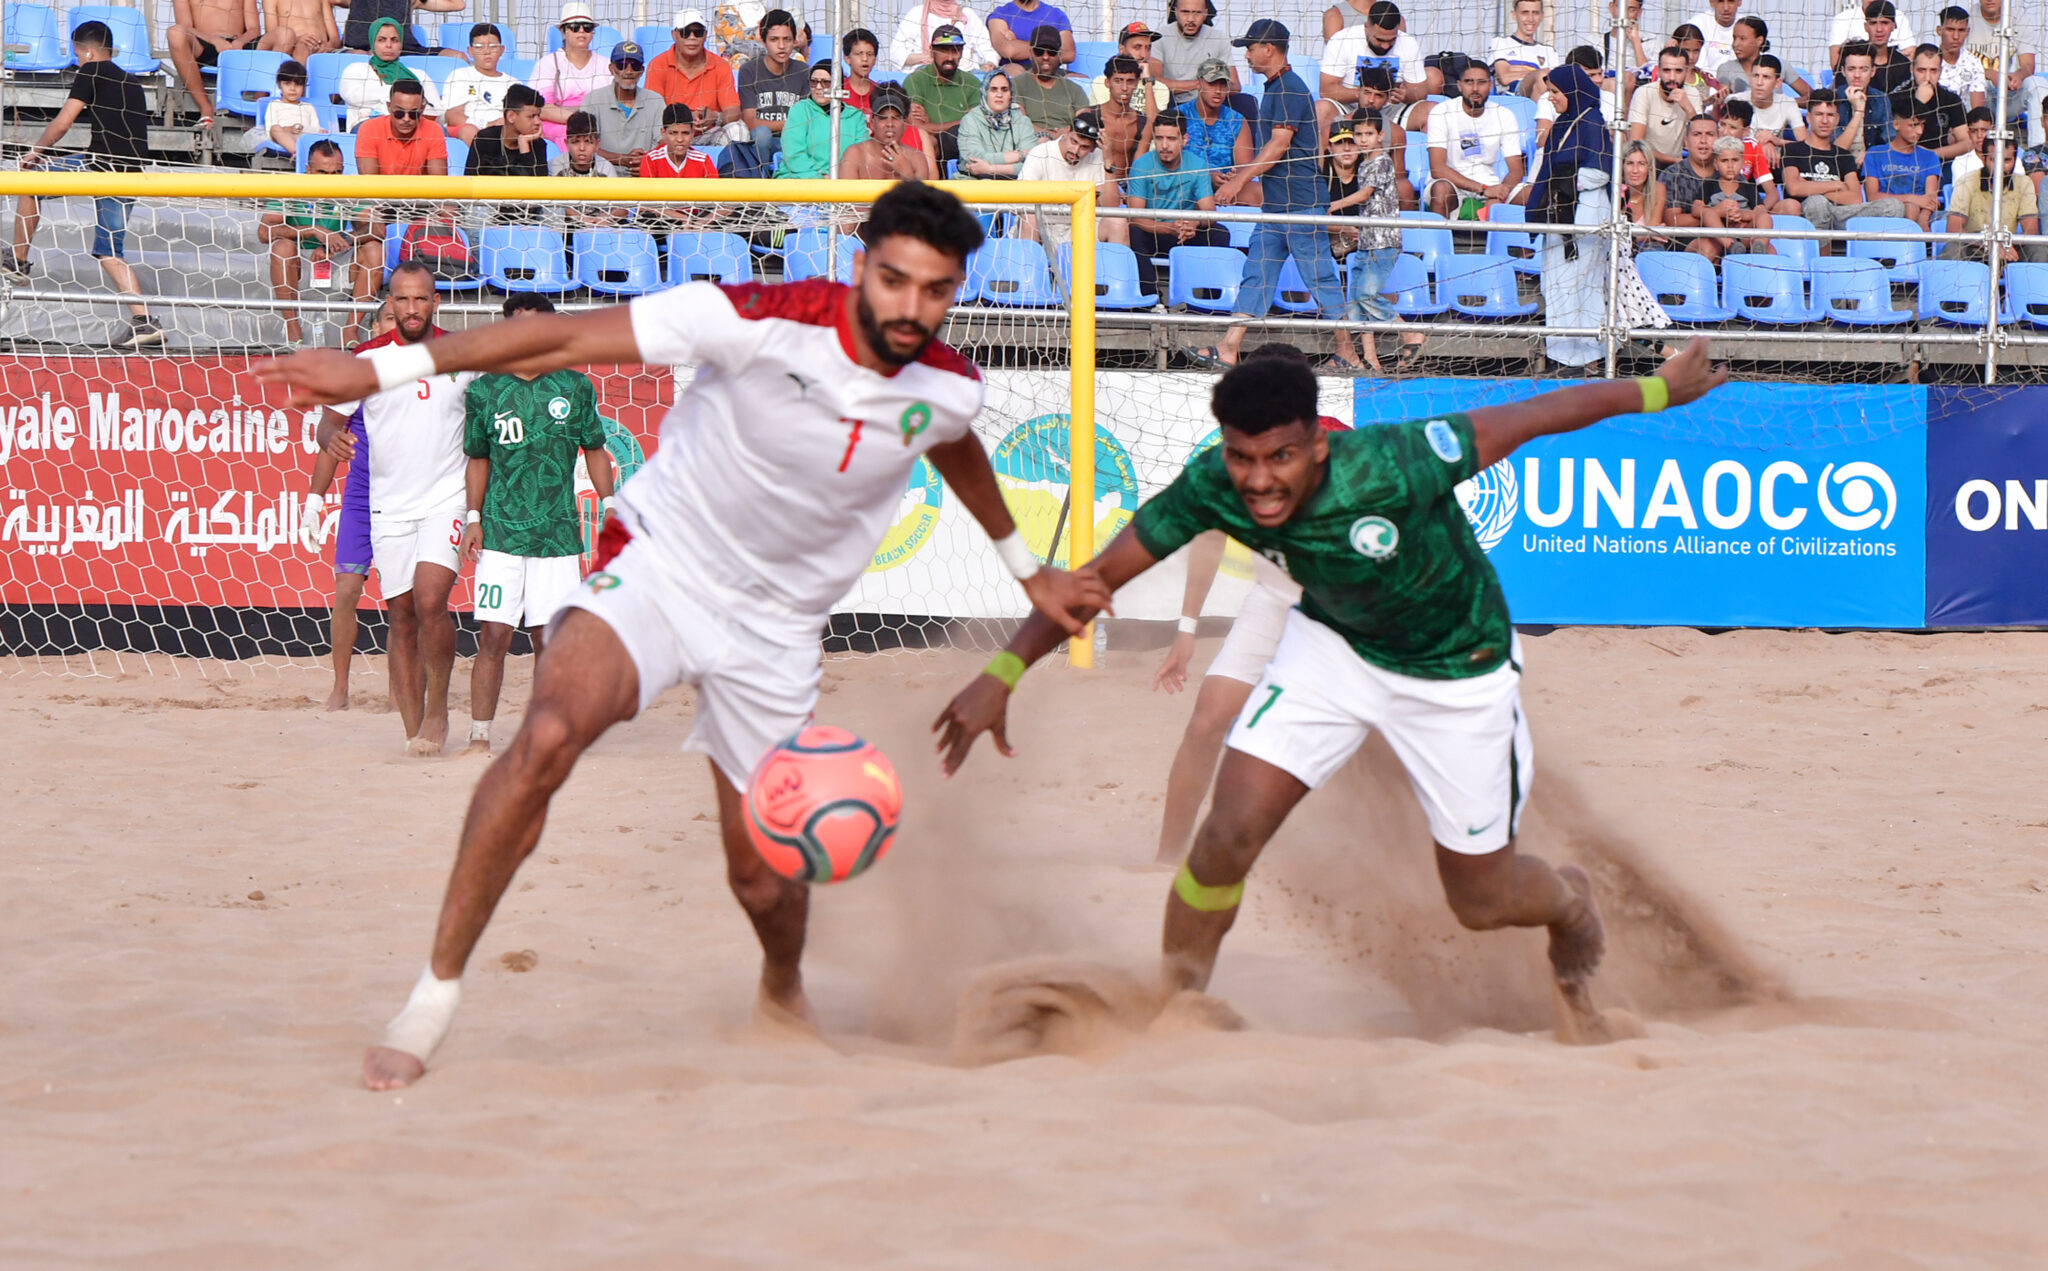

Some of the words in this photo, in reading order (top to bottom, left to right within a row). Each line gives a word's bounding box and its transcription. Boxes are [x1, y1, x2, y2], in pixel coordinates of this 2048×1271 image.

[758, 91, 774, 108] EW
[89, 392, 290, 454] Marocaine
[302, 404, 324, 455] d
[494, 417, 524, 444] 20
[837, 416, 864, 473] 7
[1525, 457, 1809, 531] UNAOC
[1955, 479, 2048, 532] ON
[2, 489, 144, 555] المغربية
[164, 490, 298, 557] الملكية
[874, 544, 907, 566] BEACH
[904, 513, 933, 550] SOCCER
[1523, 533, 1586, 553] United
[1593, 534, 1668, 554] Nations
[1672, 535, 1752, 555] Alliance
[1757, 536, 1777, 555] of
[1781, 536, 1897, 557] Civilizations
[478, 583, 503, 610] 20
[1247, 684, 1284, 729] 7
